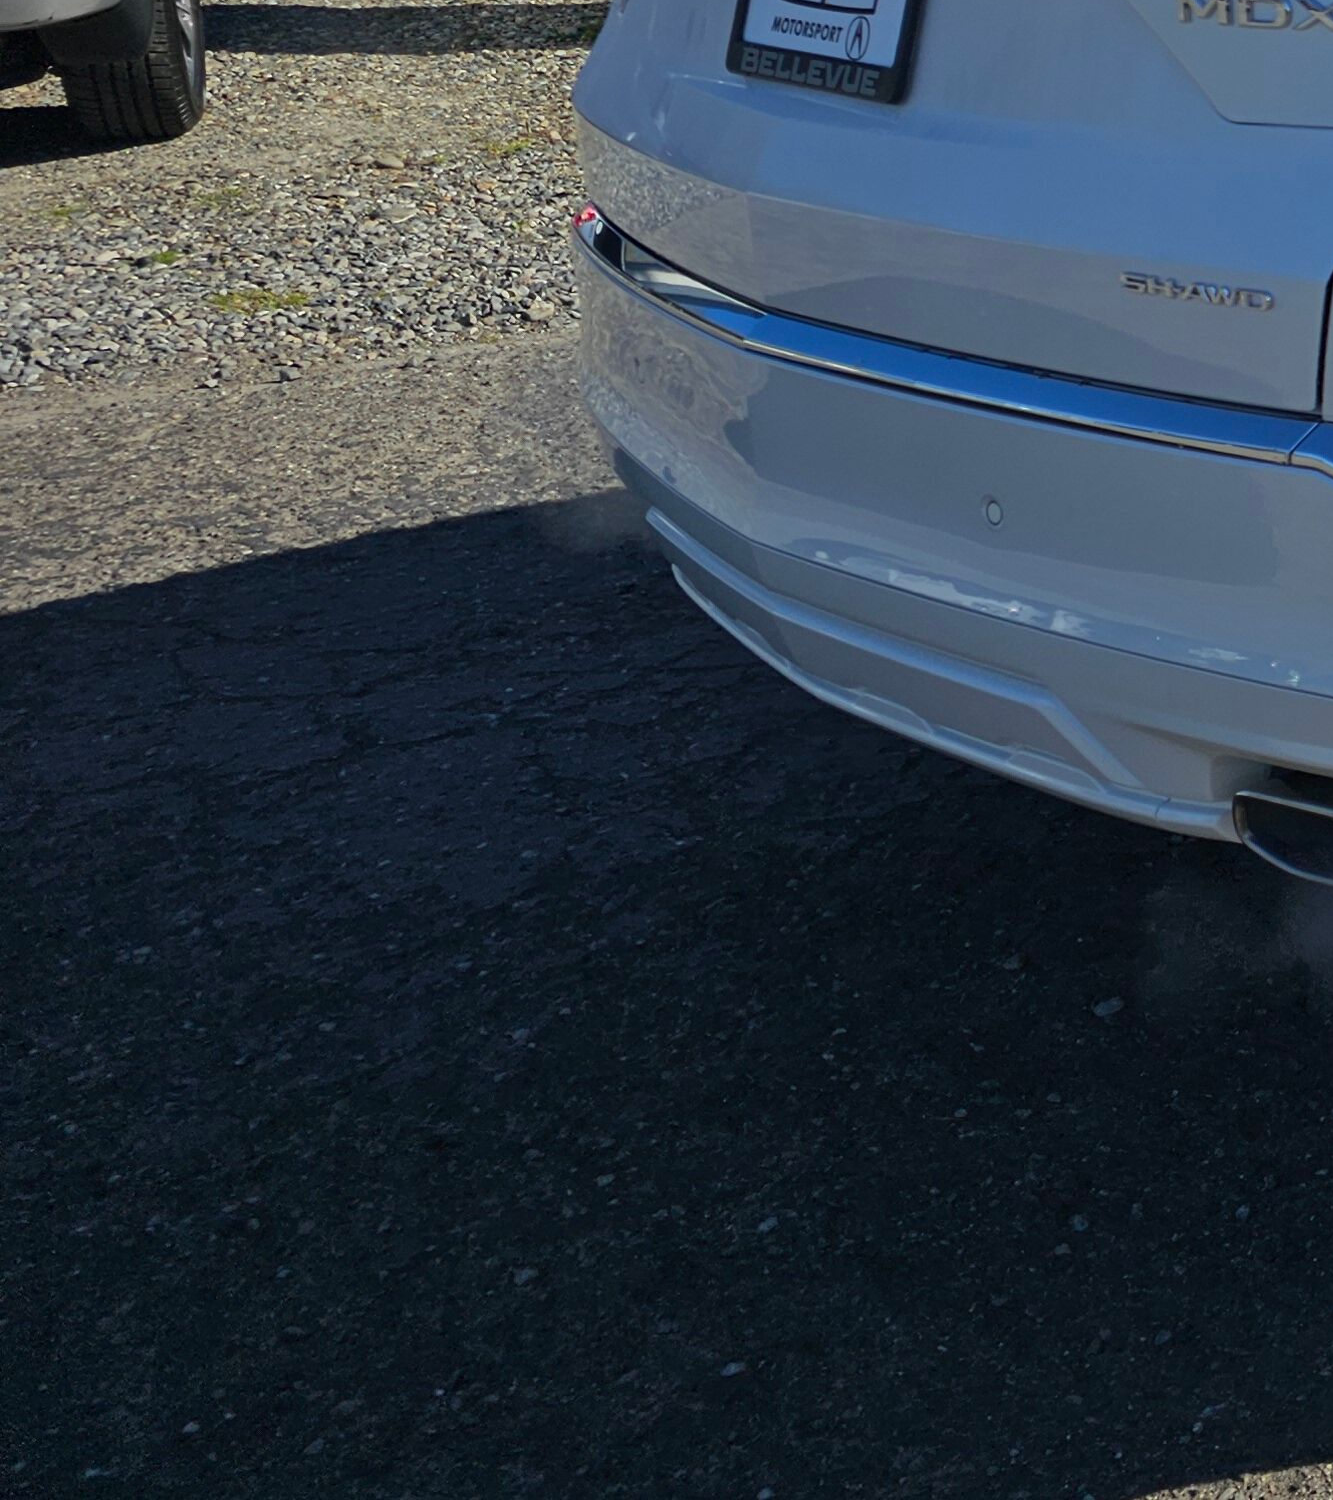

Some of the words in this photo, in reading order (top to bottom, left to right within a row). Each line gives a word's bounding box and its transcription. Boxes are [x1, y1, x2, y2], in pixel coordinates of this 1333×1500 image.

[771, 16, 844, 43] MOTORSPORT
[741, 47, 880, 97] BELLEVUE
[1119, 270, 1276, 313] SH-AWD
